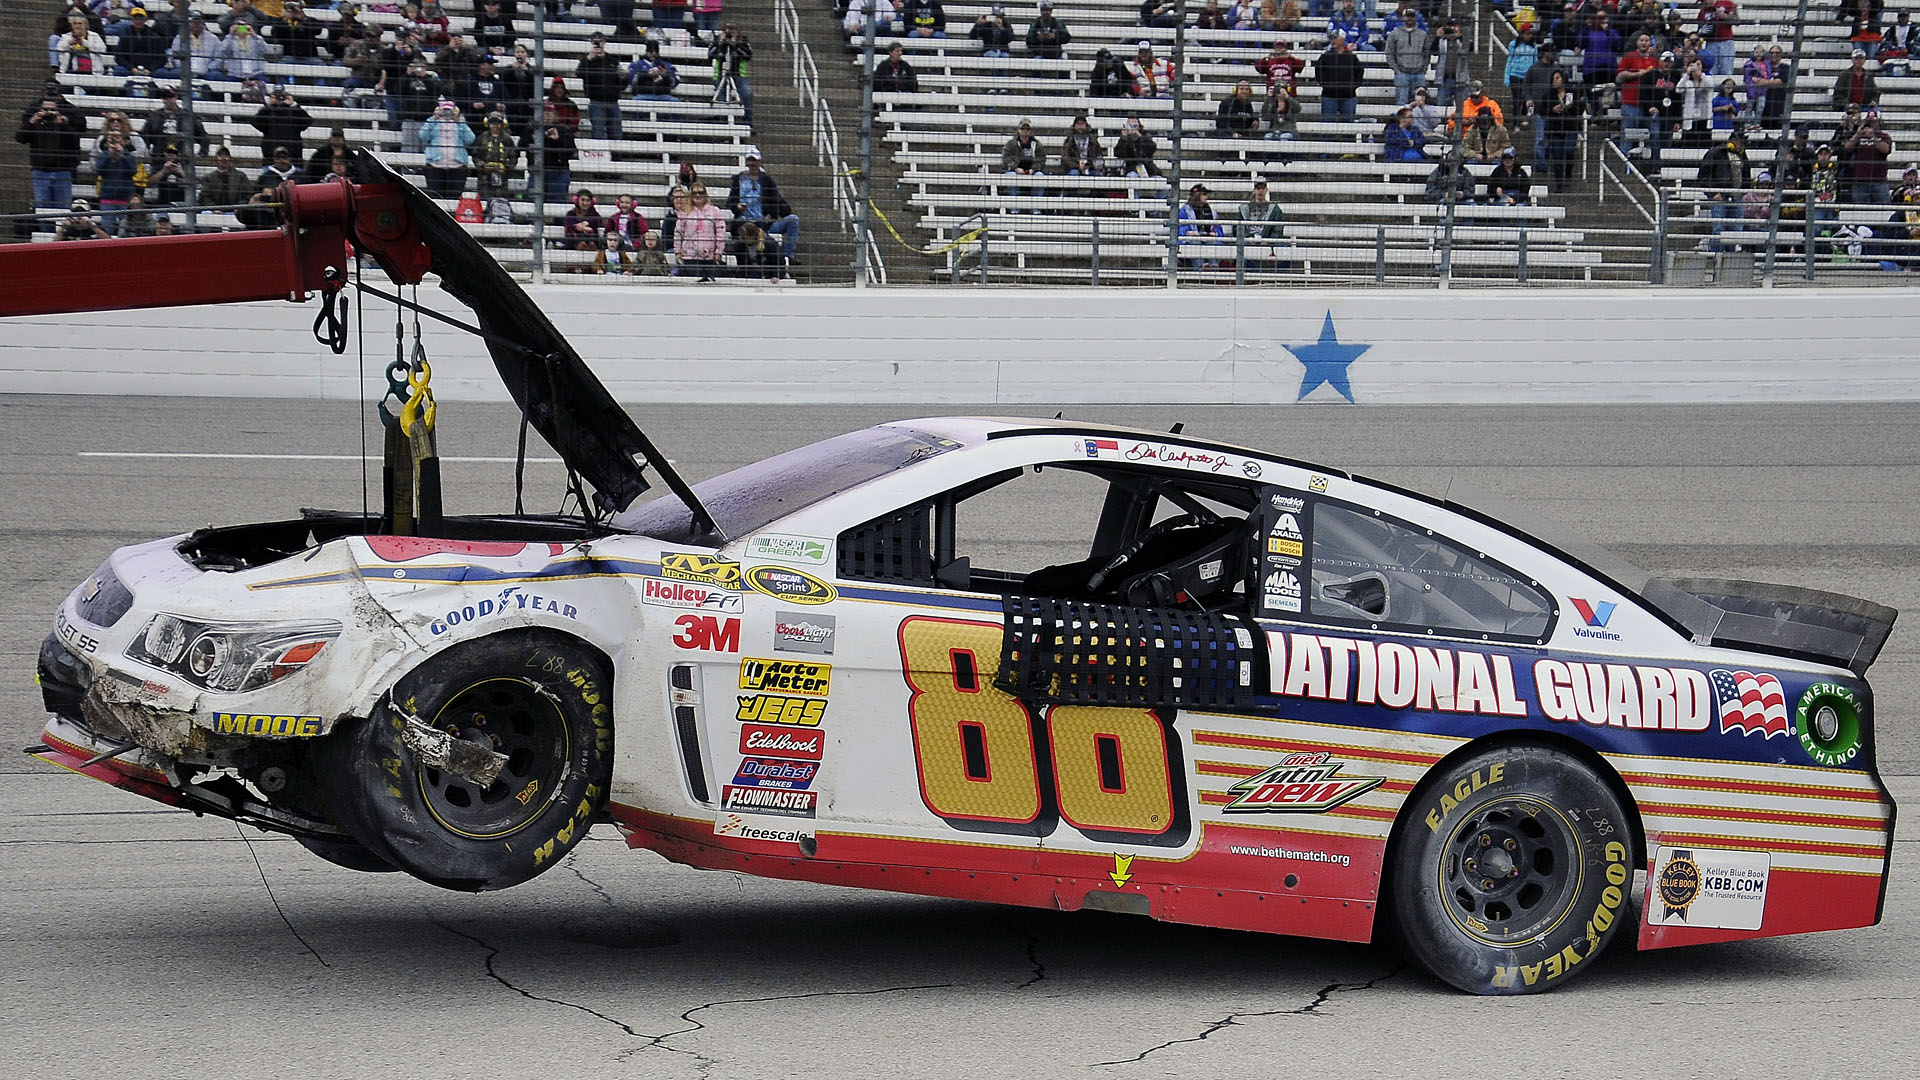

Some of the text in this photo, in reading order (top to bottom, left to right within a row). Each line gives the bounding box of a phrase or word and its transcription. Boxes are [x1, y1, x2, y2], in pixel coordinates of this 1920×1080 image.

[1271, 530, 1303, 541] AXALTA
[758, 547, 802, 557] GREEN
[769, 539, 804, 551] NASCAR
[1280, 547, 1300, 555] BOSCH
[661, 567, 741, 590] MECHANIX WEAR
[771, 572, 802, 583] NASCAR
[1264, 571, 1301, 590] MAC
[646, 581, 707, 607] Holley
[776, 582, 807, 592] Sprint
[1264, 587, 1301, 597] TOOLS
[1267, 598, 1298, 608] SIEMENS
[673, 614, 741, 653] 3M
[777, 623, 833, 639] Coors LIGHT
[1573, 627, 1621, 641] Valvoline
[77, 634, 99, 653] SS
[783, 635, 823, 643] POLE
[767, 662, 819, 676] Auto
[760, 673, 828, 691] Meter
[1266, 631, 1711, 731] NATIONAL GUARD
[1799, 683, 1863, 717] AMERICAN
[738, 696, 827, 725] JEGS
[217, 715, 320, 736] MOOG
[746, 731, 818, 753] Edelbrock
[1800, 733, 1862, 766] ETHANOL
[1283, 754, 1324, 767] diet
[742, 761, 814, 779] Duralast
[759, 779, 792, 788] BRAKES
[521, 783, 537, 802] AERO
[726, 788, 811, 809] FLOWMASTER
[1425, 762, 1507, 834] EAGLE
[740, 826, 808, 841] freescale
[1230, 845, 1350, 867] www.bethematch.org
[1667, 863, 1696, 877] KELLEY
[1706, 867, 1765, 878] Kelley Blue Book
[1662, 878, 1696, 888] BLUE BOOK
[1705, 877, 1764, 892] KBB.COM
[1737, 893, 1762, 901] Resource
